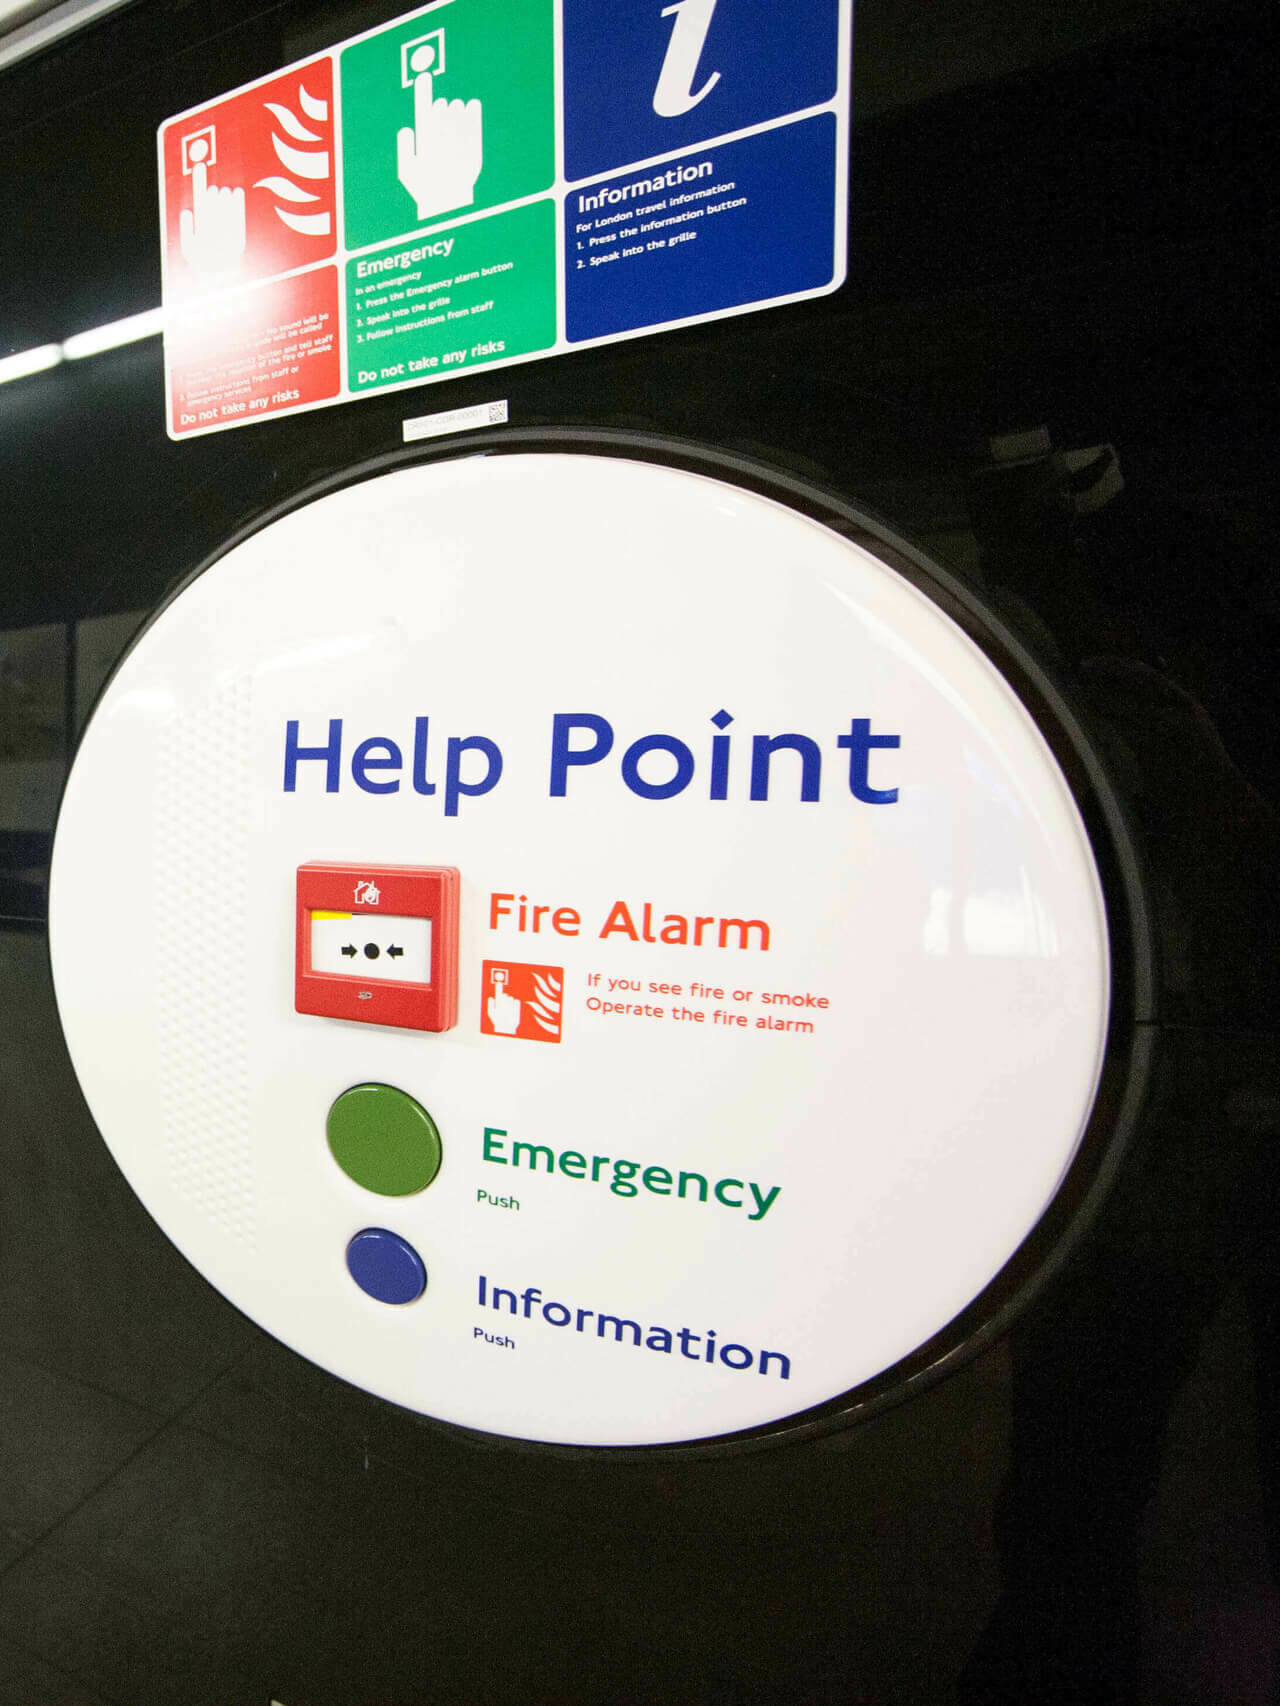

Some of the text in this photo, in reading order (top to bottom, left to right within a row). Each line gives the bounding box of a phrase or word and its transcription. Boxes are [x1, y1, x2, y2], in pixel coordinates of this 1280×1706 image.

[578, 162, 712, 213] Information
[576, 182, 736, 234] For London travel information
[576, 242, 584, 250] 1.
[589, 233, 616, 247] Press
[619, 227, 638, 238] the
[706, 197, 747, 214] button
[356, 238, 454, 278] Emergency
[576, 231, 696, 270] 2. Speak into the grille
[355, 271, 422, 296] In an emergency
[365, 297, 388, 308] Press
[389, 292, 404, 301] the
[406, 278, 453, 297] Emergency
[454, 271, 480, 284] alarm
[481, 262, 514, 276] button
[300, 322, 322, 334] called
[303, 315, 317, 326] will
[318, 312, 329, 321] be
[366, 313, 390, 326] Speak
[392, 308, 410, 317] into
[411, 303, 426, 313] the
[428, 297, 450, 310] grille
[366, 329, 394, 341] Follow
[395, 314, 446, 333] instructions
[447, 308, 469, 320] from
[471, 300, 494, 314] staff
[308, 344, 332, 356] smoke
[314, 334, 334, 346] staff
[271, 368, 288, 379] staff
[290, 366, 299, 374] or
[358, 340, 506, 384] Do not take any risks
[180, 388, 300, 425] Do not take any risks
[282, 708, 901, 817] Help Point
[489, 893, 771, 951] Fire Alarm
[587, 973, 830, 1009] If you see fire or smoke
[586, 997, 814, 1034] Operate the fire alarm
[482, 1127, 782, 1221] Emergency
[476, 1188, 520, 1212] Push
[473, 1326, 516, 1351] Push
[478, 1274, 792, 1381] Information
